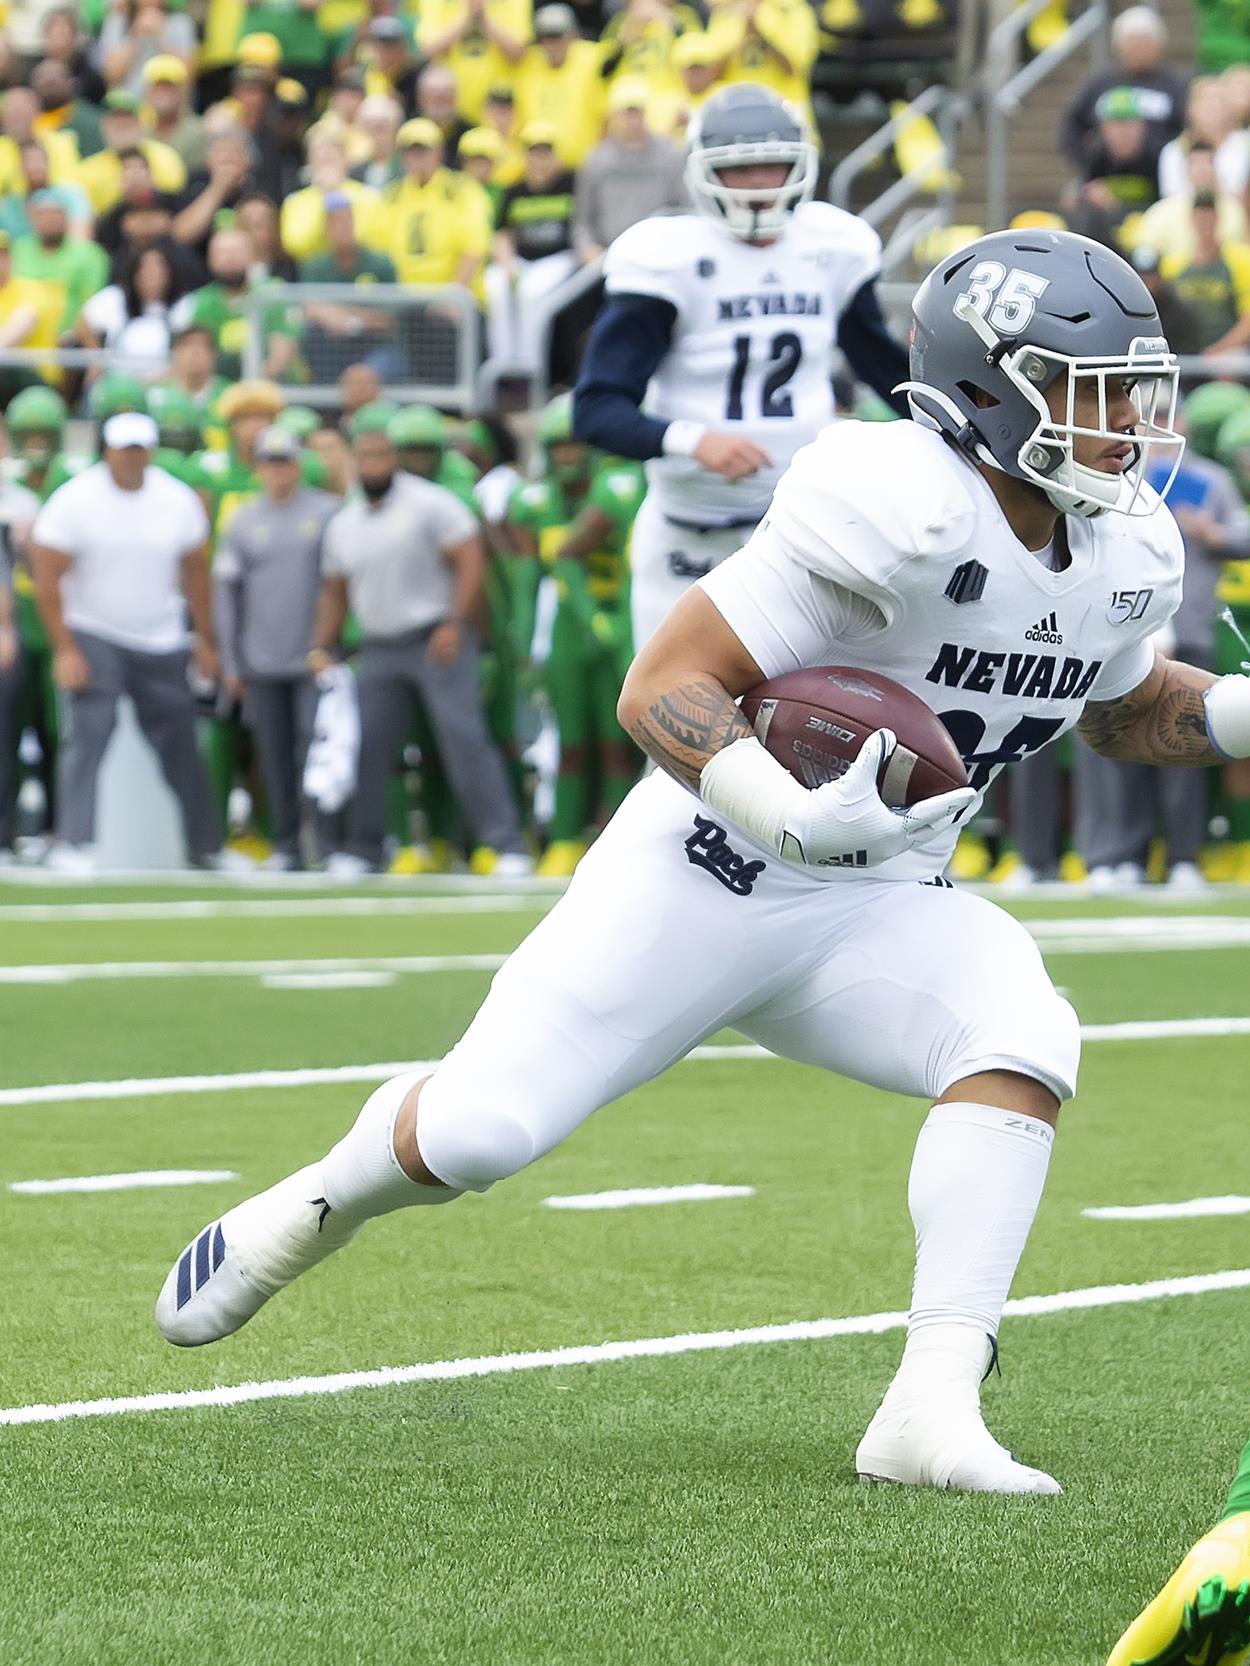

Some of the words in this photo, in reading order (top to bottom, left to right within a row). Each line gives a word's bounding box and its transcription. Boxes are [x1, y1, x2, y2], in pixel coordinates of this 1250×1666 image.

[717, 292, 821, 320] NEVADA
[952, 260, 1050, 335] 35
[726, 334, 803, 420] 12
[1024, 629, 1063, 645] adidas
[925, 642, 1103, 700] NEVADA
[805, 715, 857, 744] DIME
[684, 812, 767, 896] Pack
[1004, 1117, 1052, 1142] ZEN
